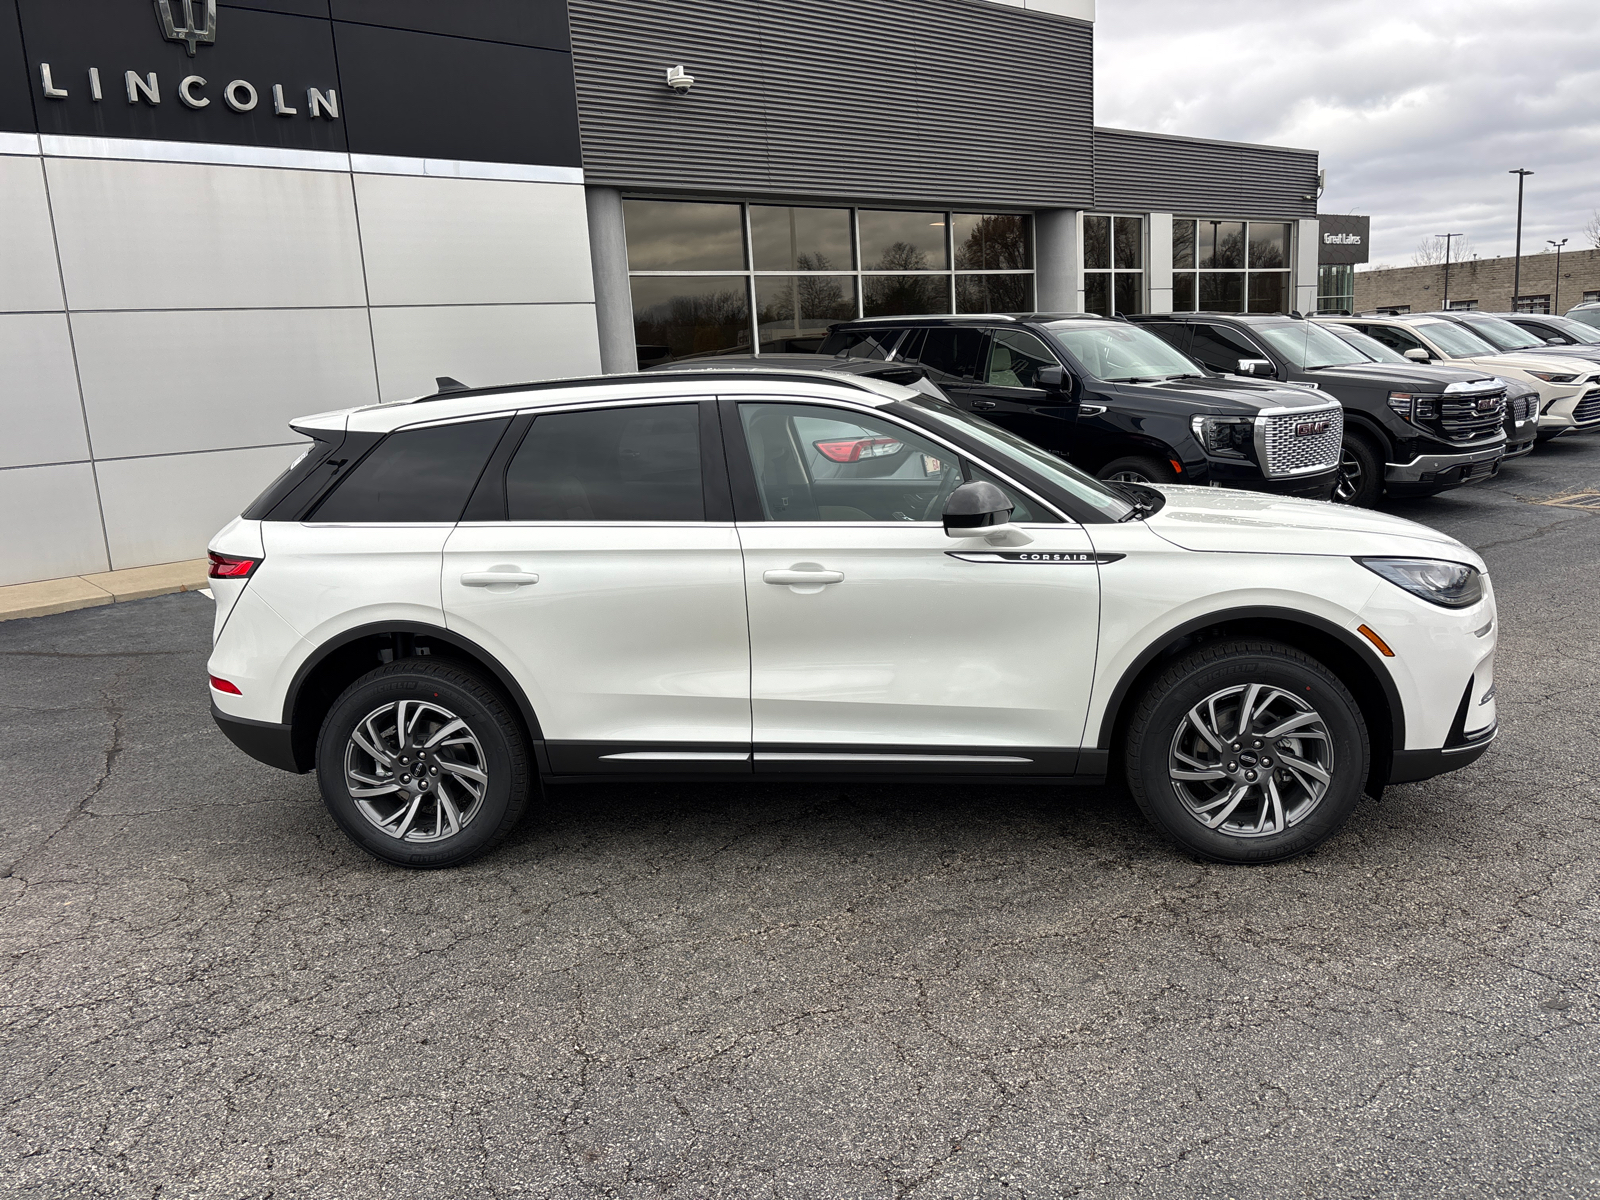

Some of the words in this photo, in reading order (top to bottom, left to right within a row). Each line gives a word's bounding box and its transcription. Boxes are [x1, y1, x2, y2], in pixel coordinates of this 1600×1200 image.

[39, 62, 339, 119] LINCOLN
[1323, 233, 1342, 244] Great
[1343, 233, 1361, 245] Lakes
[1297, 421, 1330, 435] GMC
[1019, 553, 1088, 561] CORSAIR
[1199, 663, 1256, 685] MICHELIN
[369, 681, 416, 696] MICHELIN
